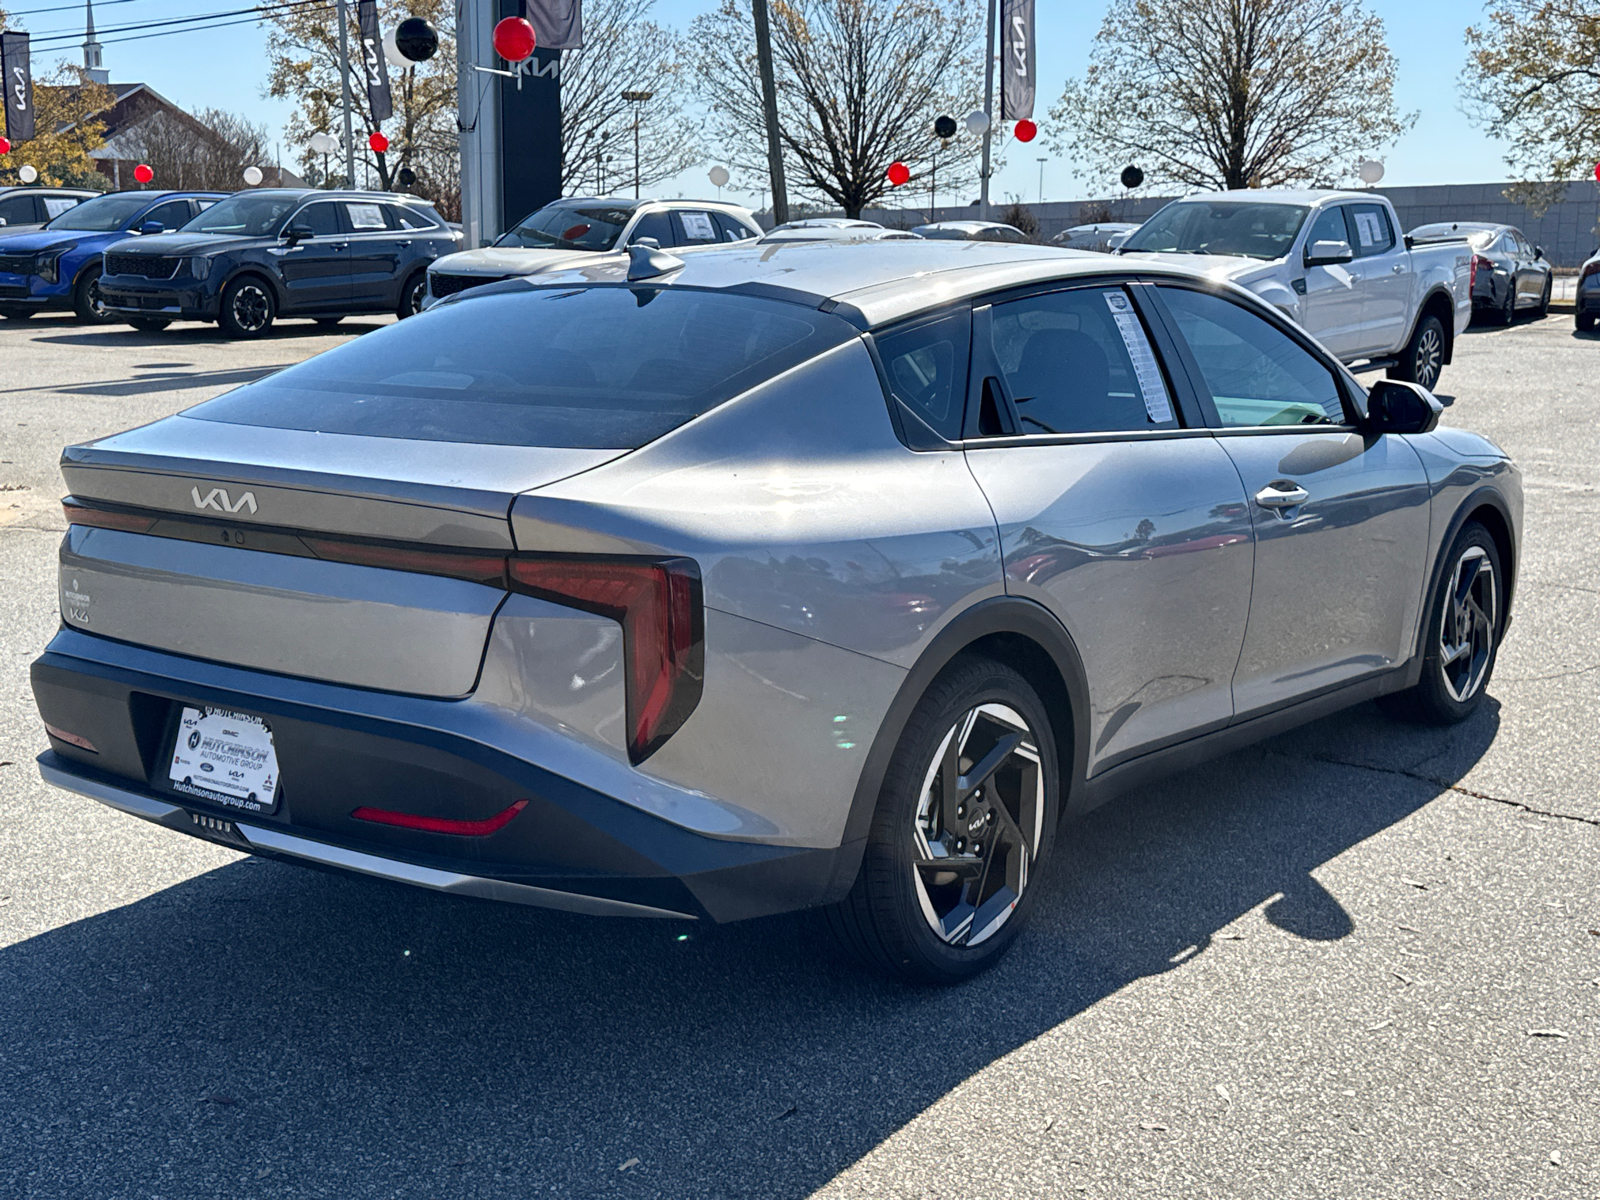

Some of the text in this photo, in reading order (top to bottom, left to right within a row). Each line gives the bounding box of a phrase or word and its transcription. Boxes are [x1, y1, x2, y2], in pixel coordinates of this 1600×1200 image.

[363, 38, 382, 86] KIA
[1012, 15, 1028, 77] KIA
[13, 66, 26, 111] KIA
[191, 485, 259, 515] KIA
[199, 750, 240, 766] AUTOMOTIVE
[240, 759, 263, 771] GROUP
[201, 737, 270, 764] HUTCHINSON
[173, 780, 261, 812] Hutchinsonautogroup.com
